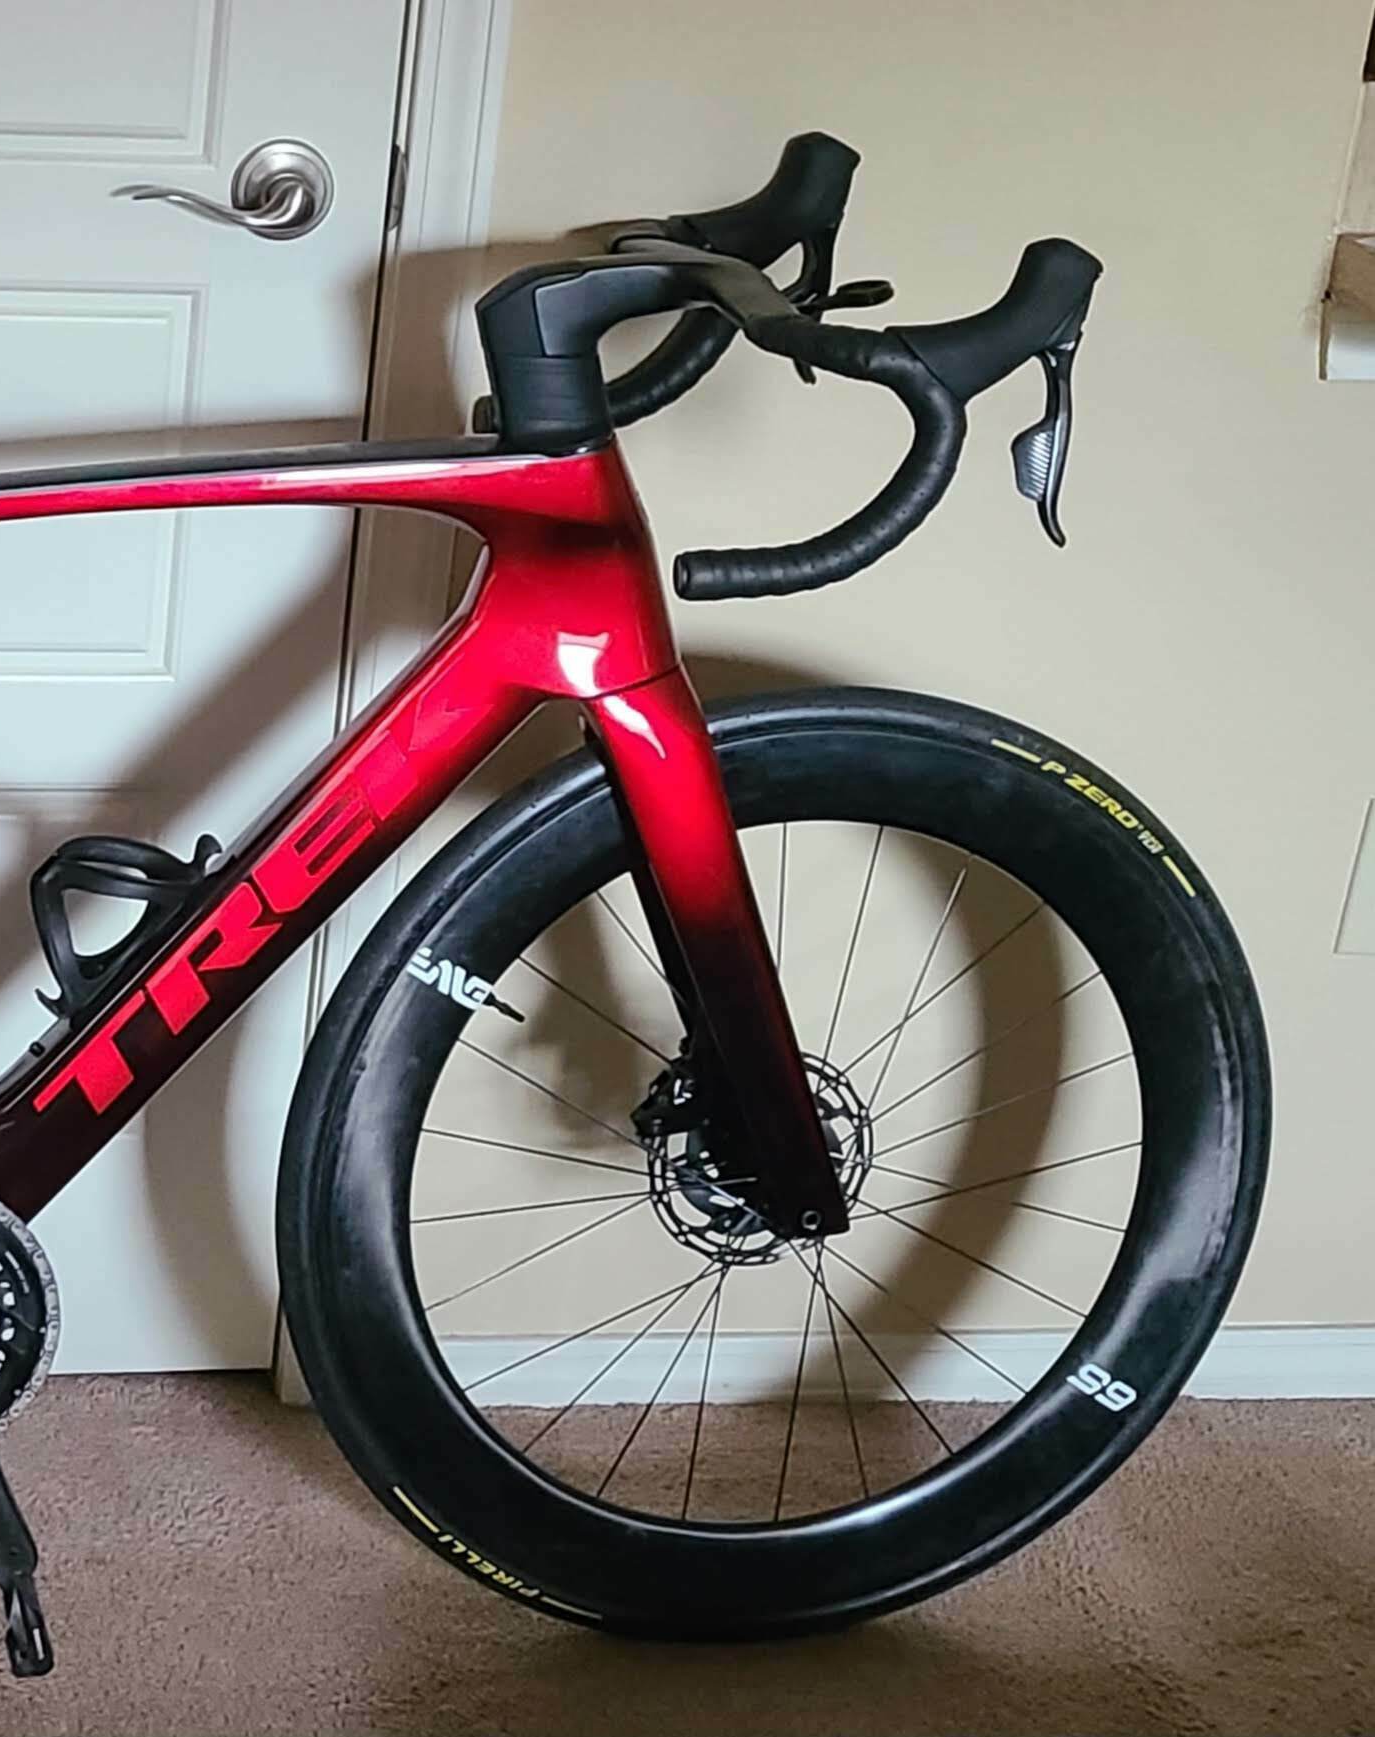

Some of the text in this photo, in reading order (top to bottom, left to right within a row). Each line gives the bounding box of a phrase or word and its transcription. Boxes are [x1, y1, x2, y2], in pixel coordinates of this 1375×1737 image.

[1040, 761, 1139, 829] P ZERO
[33, 654, 494, 1115] TREK
[406, 947, 494, 1012] ENVE
[438, 1534, 541, 1598] PIRELLI
